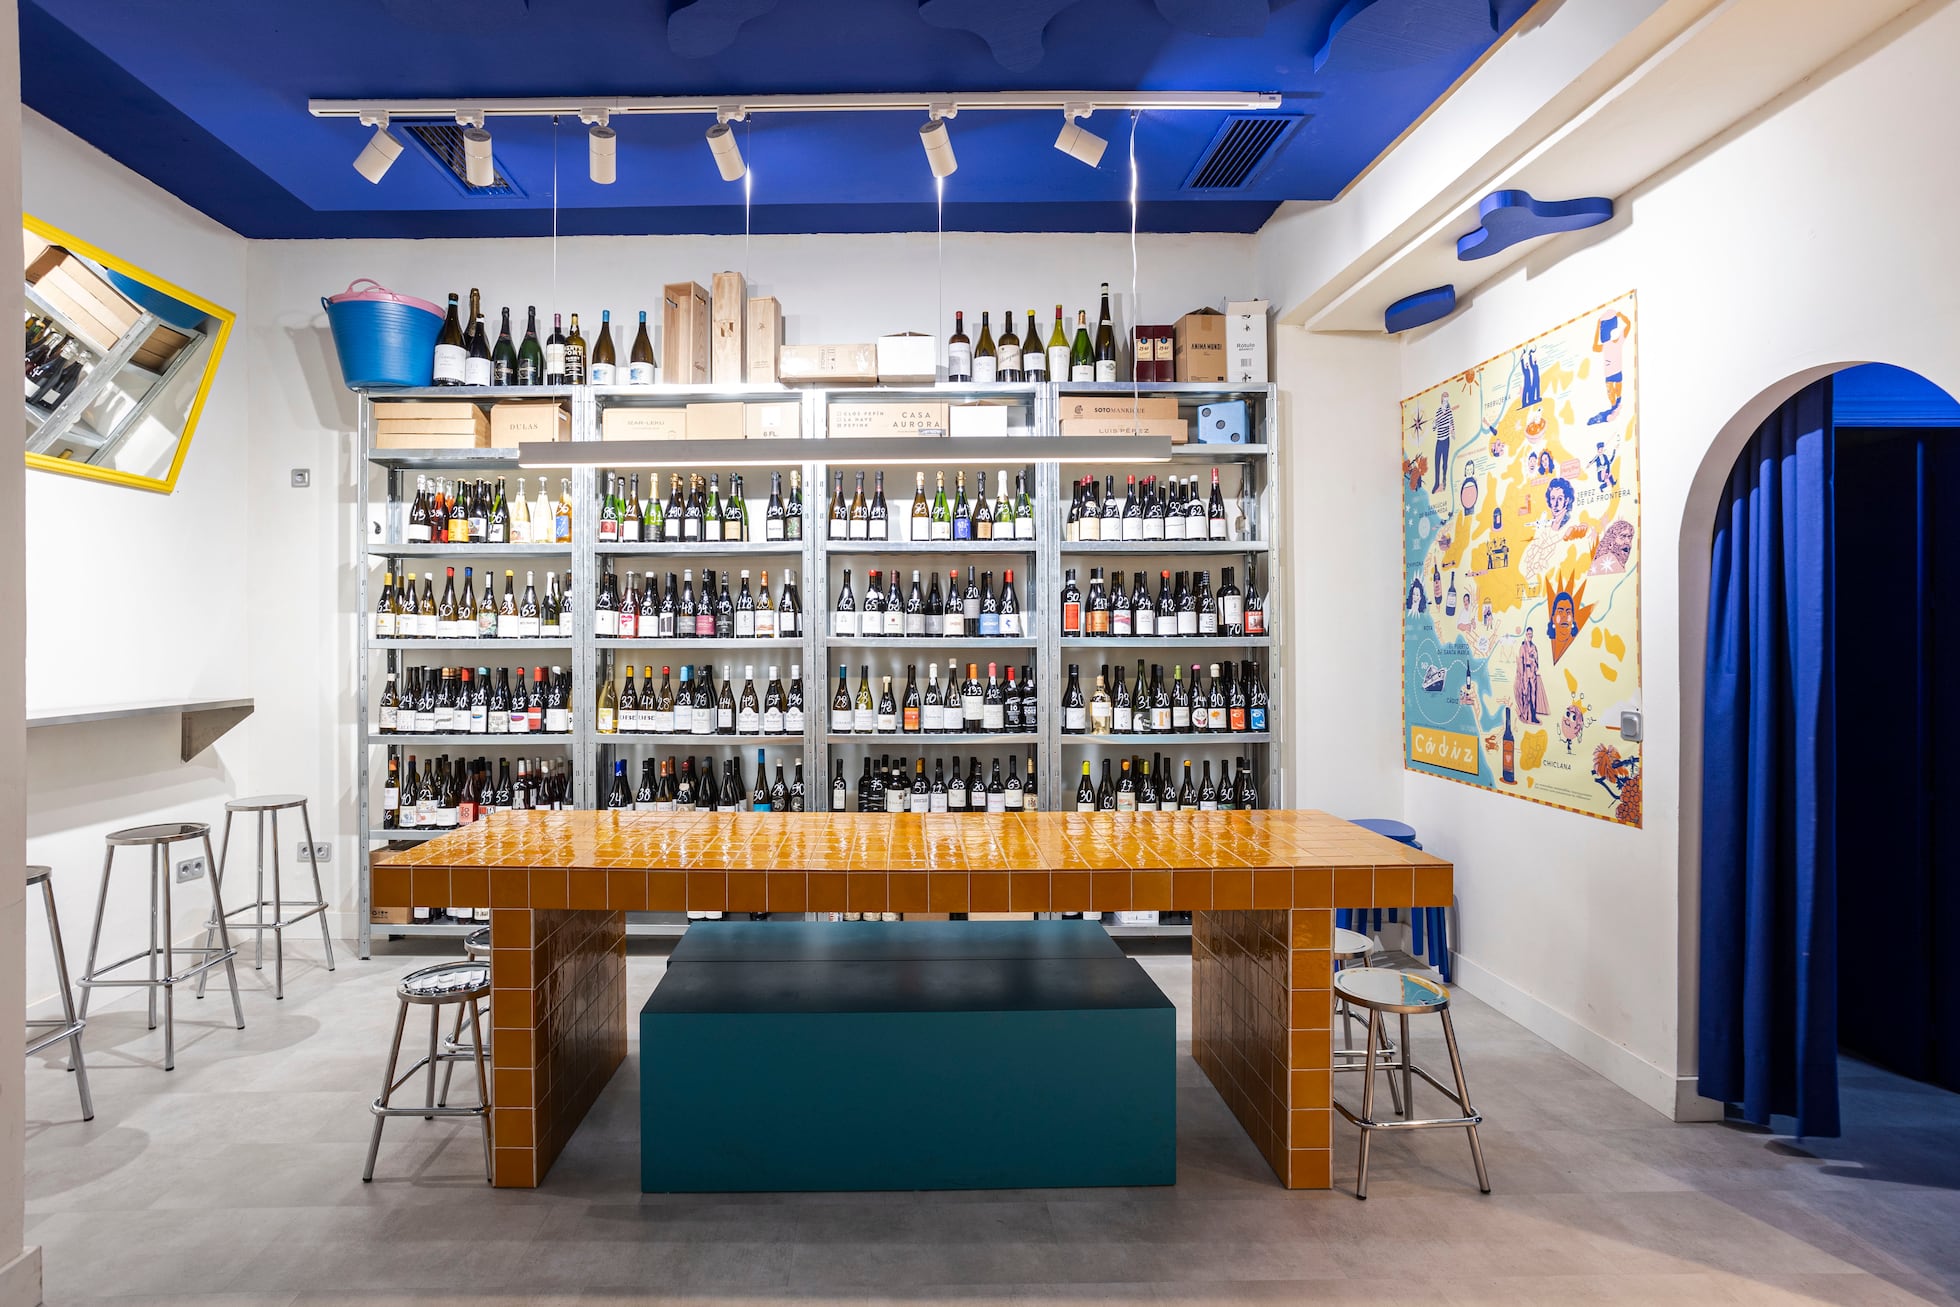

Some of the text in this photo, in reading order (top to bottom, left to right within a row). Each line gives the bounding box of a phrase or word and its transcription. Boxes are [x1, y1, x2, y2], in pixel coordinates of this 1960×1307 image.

[902, 411, 931, 419] CASA
[1578, 489, 1596, 498] JEREZ
[1597, 489, 1631, 501] FRONTERA
[980, 508, 990, 520] 96
[1190, 506, 1202, 517] 62
[967, 586, 978, 598] 20
[1067, 592, 1079, 602] 50
[682, 601, 694, 614] 48
[839, 597, 854, 610] 162
[866, 599, 877, 611] 65
[908, 599, 920, 612] 57
[951, 598, 963, 611] 45
[983, 599, 996, 612] 38
[1001, 601, 1013, 614] 26
[1138, 599, 1150, 610] 54
[1161, 599, 1175, 612] 42
[440, 603, 453, 617] 50
[458, 607, 471, 619] 50
[522, 604, 536, 617] 63
[642, 607, 653, 616] 60
[1229, 623, 1241, 635] 70
[968, 686, 982, 696] 133
[399, 694, 412, 708] 24
[455, 698, 467, 708] 30
[472, 692, 484, 706] 39
[490, 697, 503, 710] 32
[512, 697, 524, 710] 33
[548, 694, 560, 707] 38
[621, 696, 634, 709] 32
[657, 697, 670, 710] 28
[680, 693, 691, 705] 28
[694, 694, 706, 708] 26
[719, 697, 731, 708] 44
[742, 695, 754, 707] 42
[768, 694, 780, 706] 57
[787, 693, 802, 706] 136
[836, 696, 847, 708] 28
[858, 692, 868, 704] 28
[908, 693, 918, 707] 19
[1070, 695, 1084, 708] 30
[1138, 696, 1151, 709] 31
[1156, 695, 1169, 707] 30
[1211, 693, 1224, 707] 90
[418, 698, 434, 711] 30
[1415, 734, 1473, 763] Cádiz
[1543, 759, 1571, 770] CHICLANA
[773, 782, 784, 796] 28
[834, 780, 844, 790] 50
[952, 779, 964, 790] 63
[973, 782, 984, 792] 20
[1008, 779, 1020, 790] 63
[481, 791, 492, 804] 33
[496, 791, 509, 803] 33
[609, 792, 622, 806] 24
[638, 788, 650, 801] 38
[677, 791, 688, 802] 25
[1080, 790, 1092, 802] 30
[1165, 787, 1175, 799] 26
[1185, 789, 1197, 804] 43
[1202, 787, 1215, 800] 35
[1221, 787, 1233, 800] 30
[1243, 789, 1256, 801] 33
